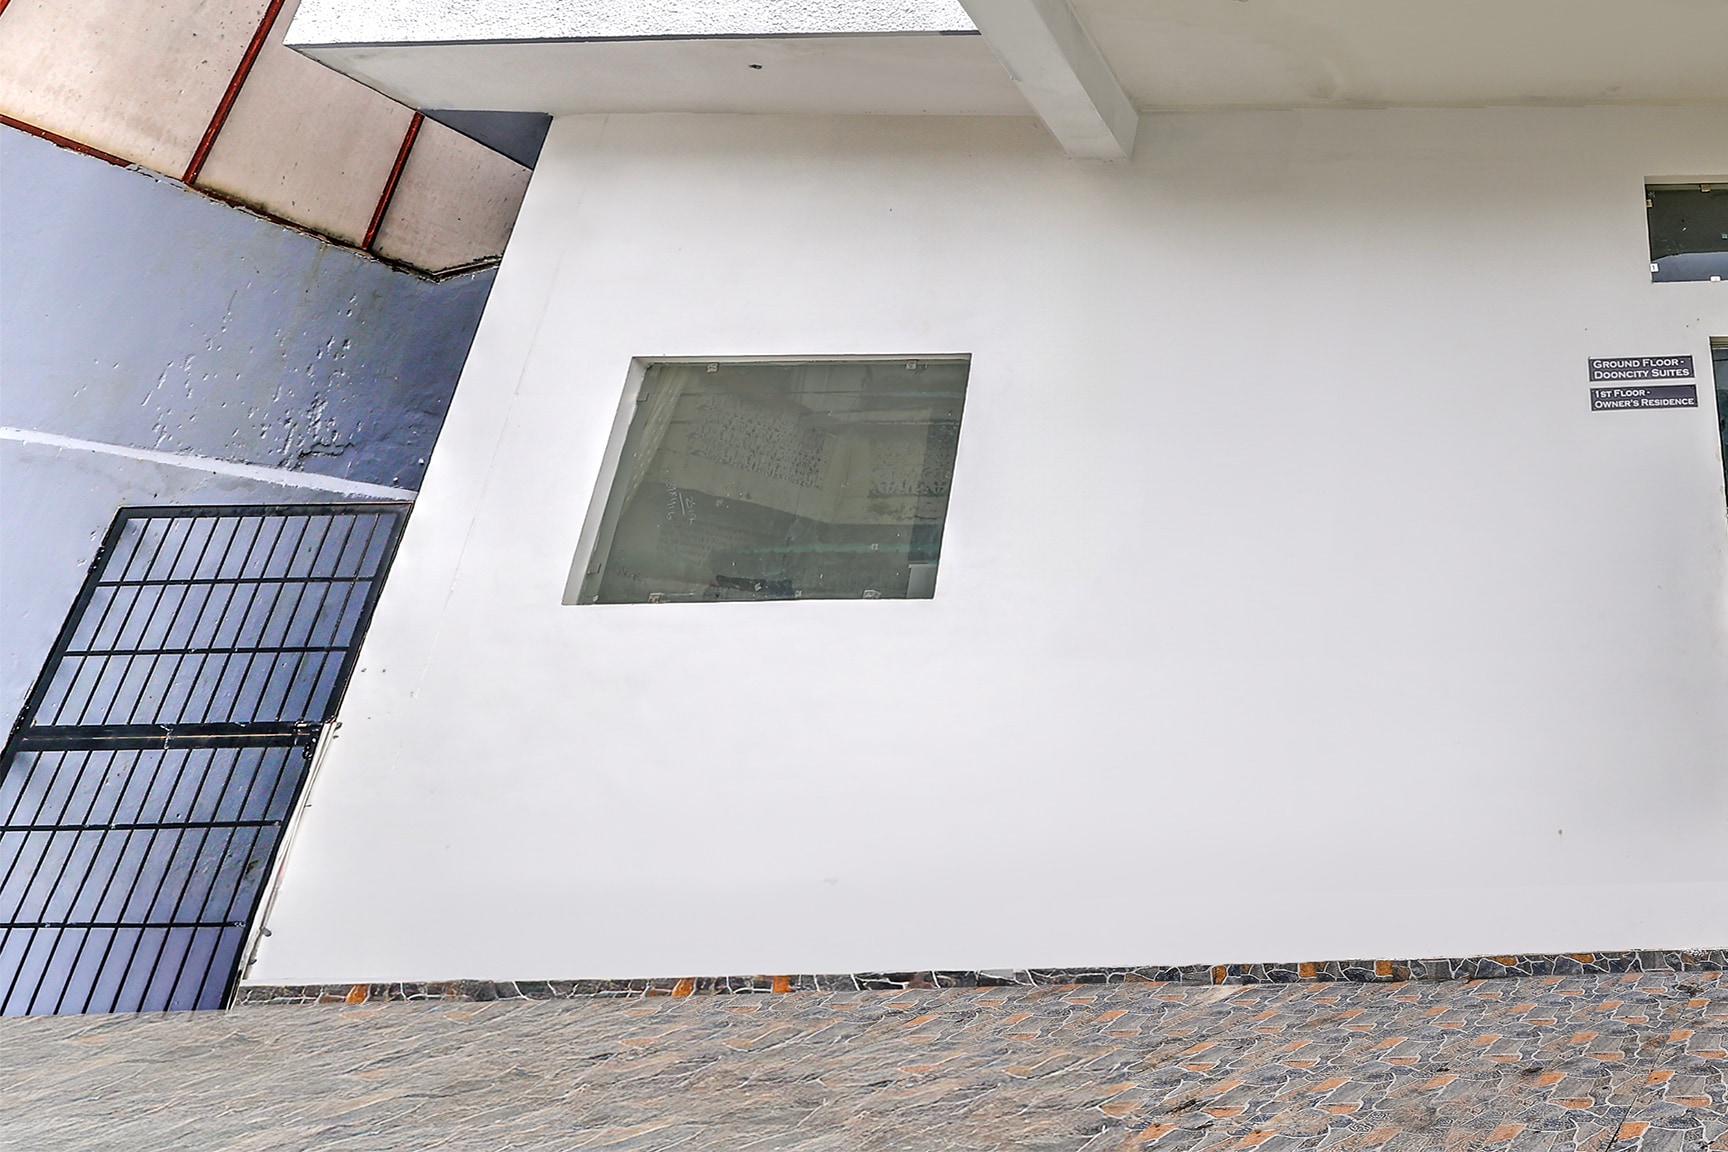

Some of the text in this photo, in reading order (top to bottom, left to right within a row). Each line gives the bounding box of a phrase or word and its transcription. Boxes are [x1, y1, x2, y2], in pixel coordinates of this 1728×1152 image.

[1593, 359, 1641, 369] GROUND
[1594, 368, 1690, 380] DOONCITY SUITES
[1594, 397, 1695, 409] OWNER'S RESIDENCE
